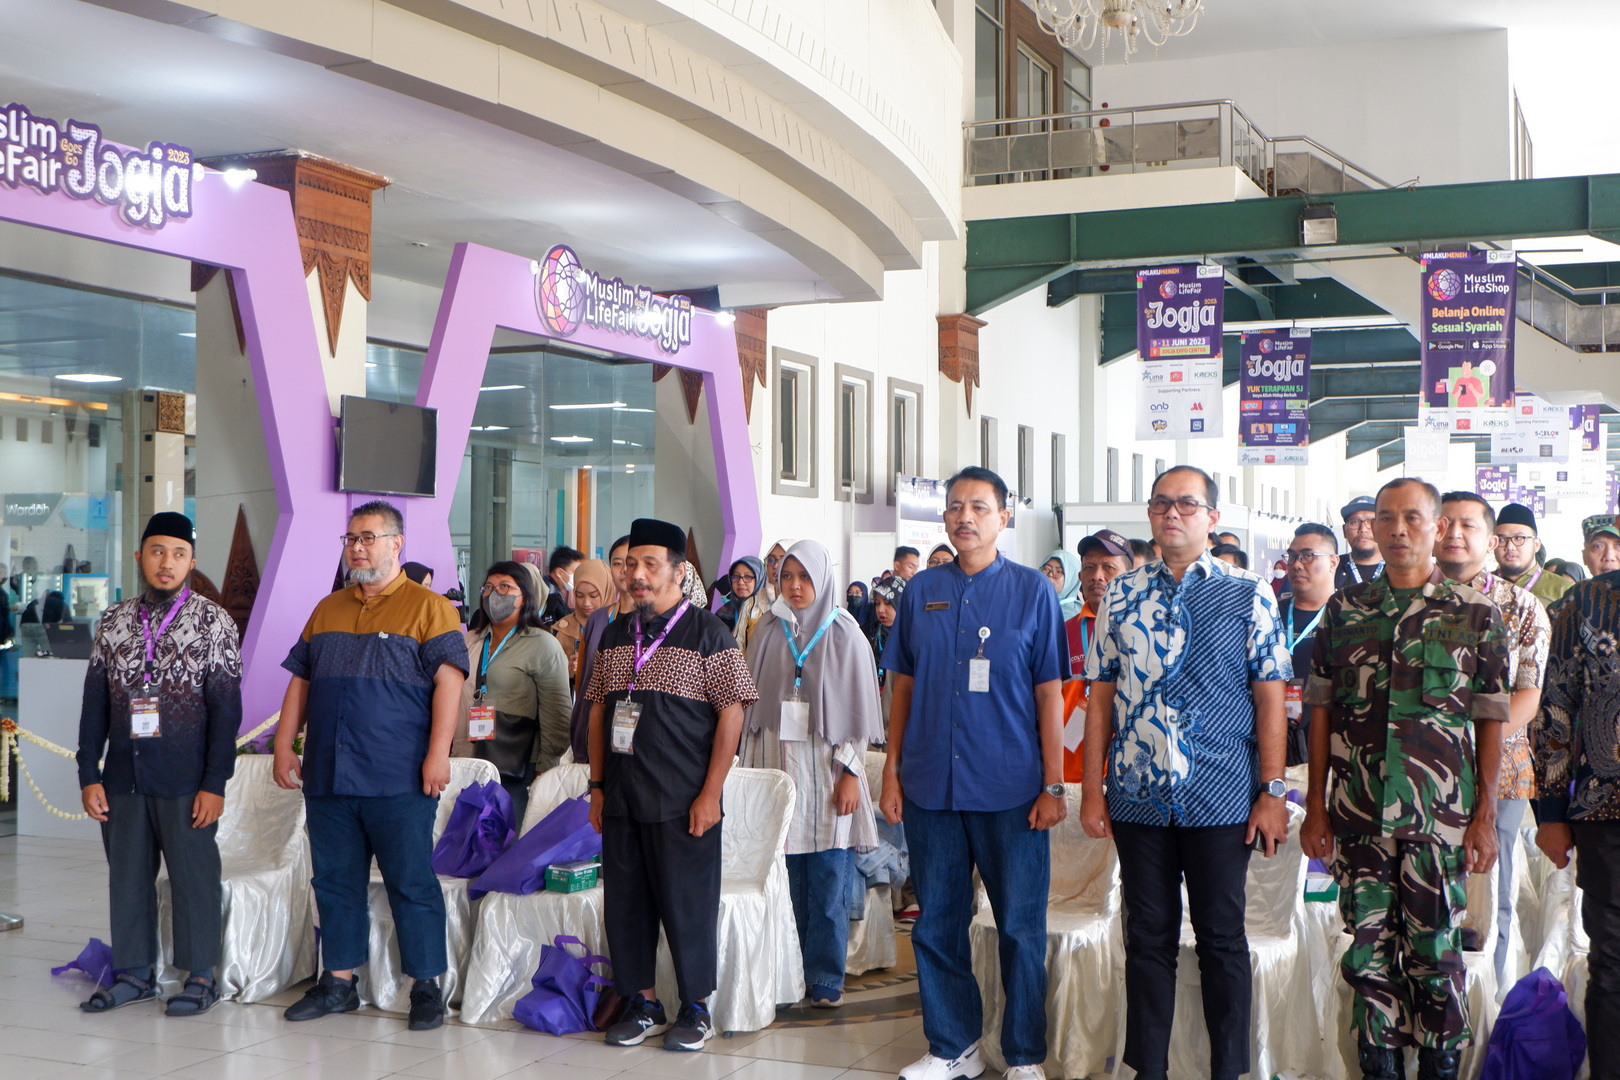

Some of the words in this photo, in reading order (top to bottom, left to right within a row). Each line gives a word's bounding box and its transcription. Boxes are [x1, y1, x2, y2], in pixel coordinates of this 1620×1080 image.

[61, 138, 83, 154] Goes
[167, 148, 190, 165] 2023
[67, 124, 190, 226] Jogja
[1464, 273, 1505, 283] Muslim
[586, 273, 634, 308] Muslim
[1464, 283, 1510, 294] LifeShop
[586, 299, 635, 331] LifeFair
[1147, 300, 1216, 333] Jogja
[1432, 306, 1470, 320] Belanja
[1471, 305, 1506, 316] Online
[1431, 321, 1465, 334] Sesuai
[1465, 320, 1503, 334] Syariah
[1162, 339, 1170, 347] 11
[1172, 338, 1188, 346] JUNI
[1189, 337, 1206, 346] 2023
[1248, 354, 1305, 381] Jogja
[1247, 385, 1261, 393] YUK
[1480, 478, 1507, 492] Jogja
[6, 503, 50, 516] Wardah
[1428, 628, 1452, 640] TNI
[1457, 631, 1476, 643] AD
